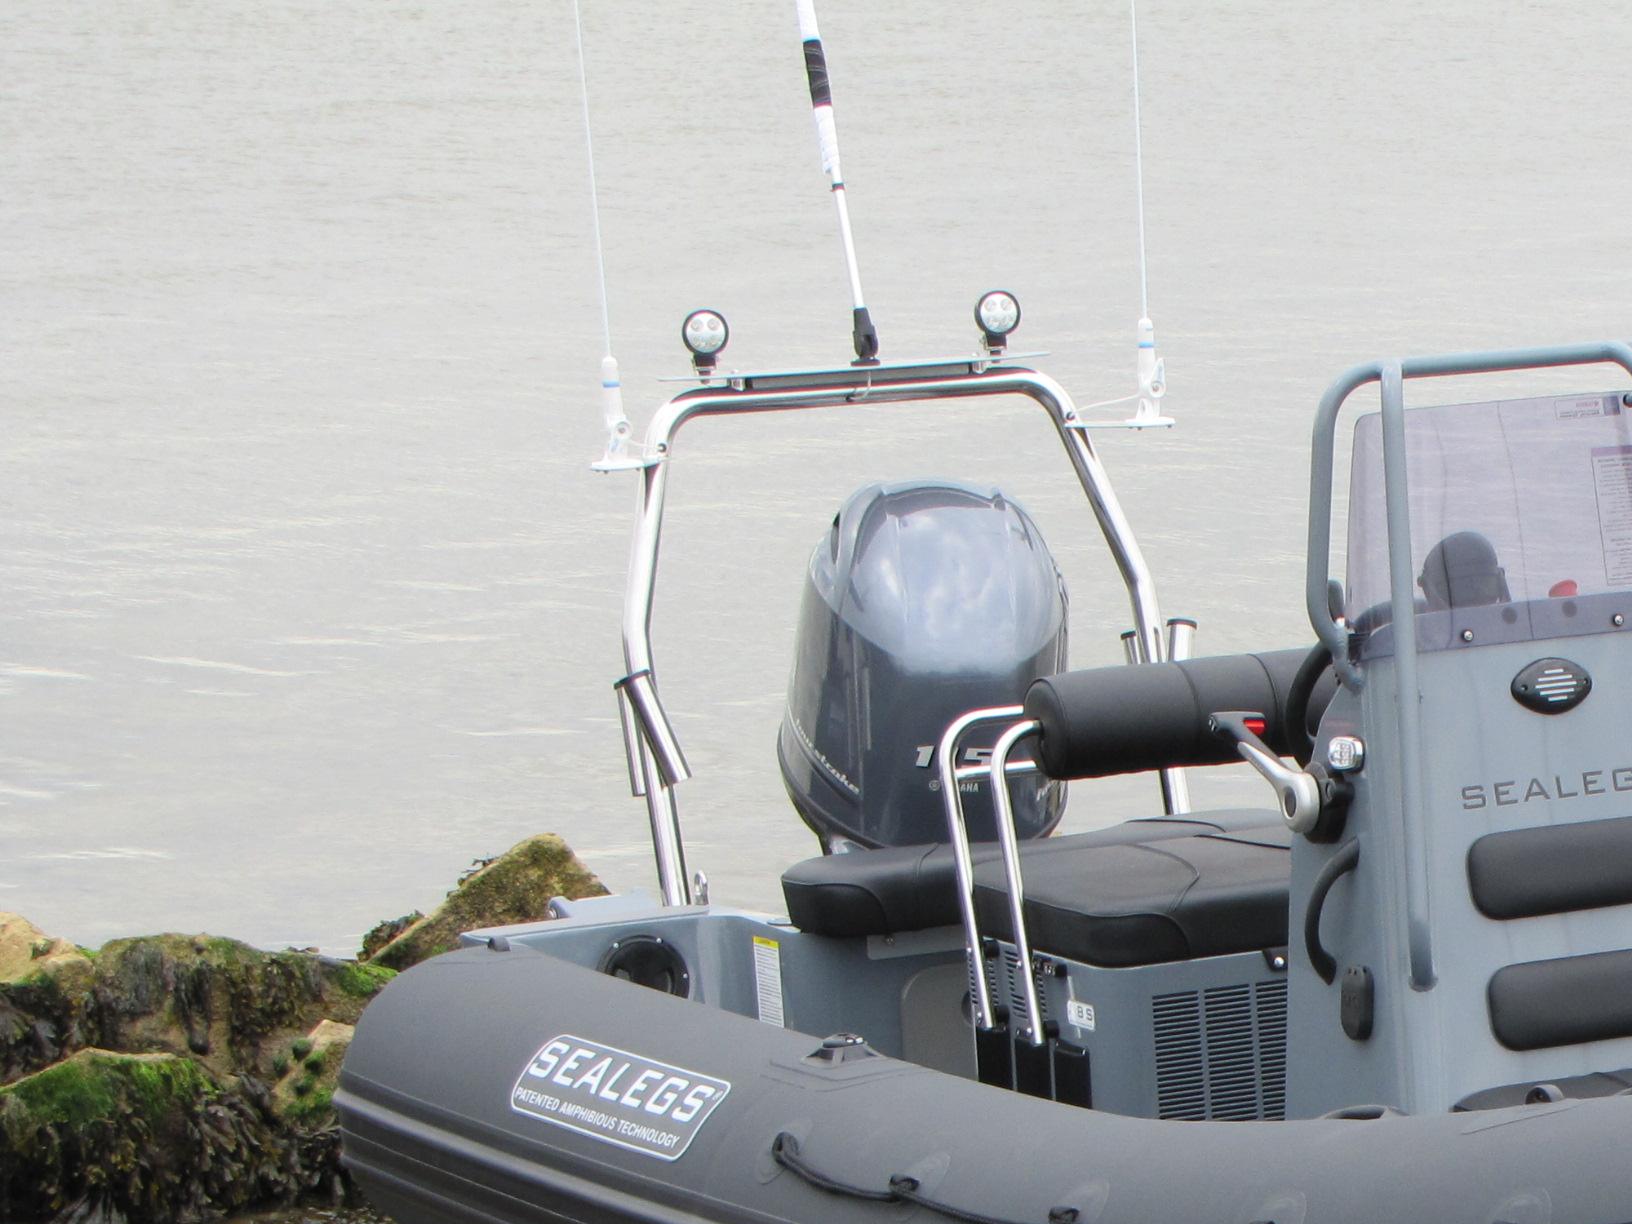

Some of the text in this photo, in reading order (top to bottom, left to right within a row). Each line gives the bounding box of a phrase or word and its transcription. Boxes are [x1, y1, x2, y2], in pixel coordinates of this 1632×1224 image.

[514, 1086, 681, 1149] PATENTED AMPHIBIOUS TECHNOLOGY
